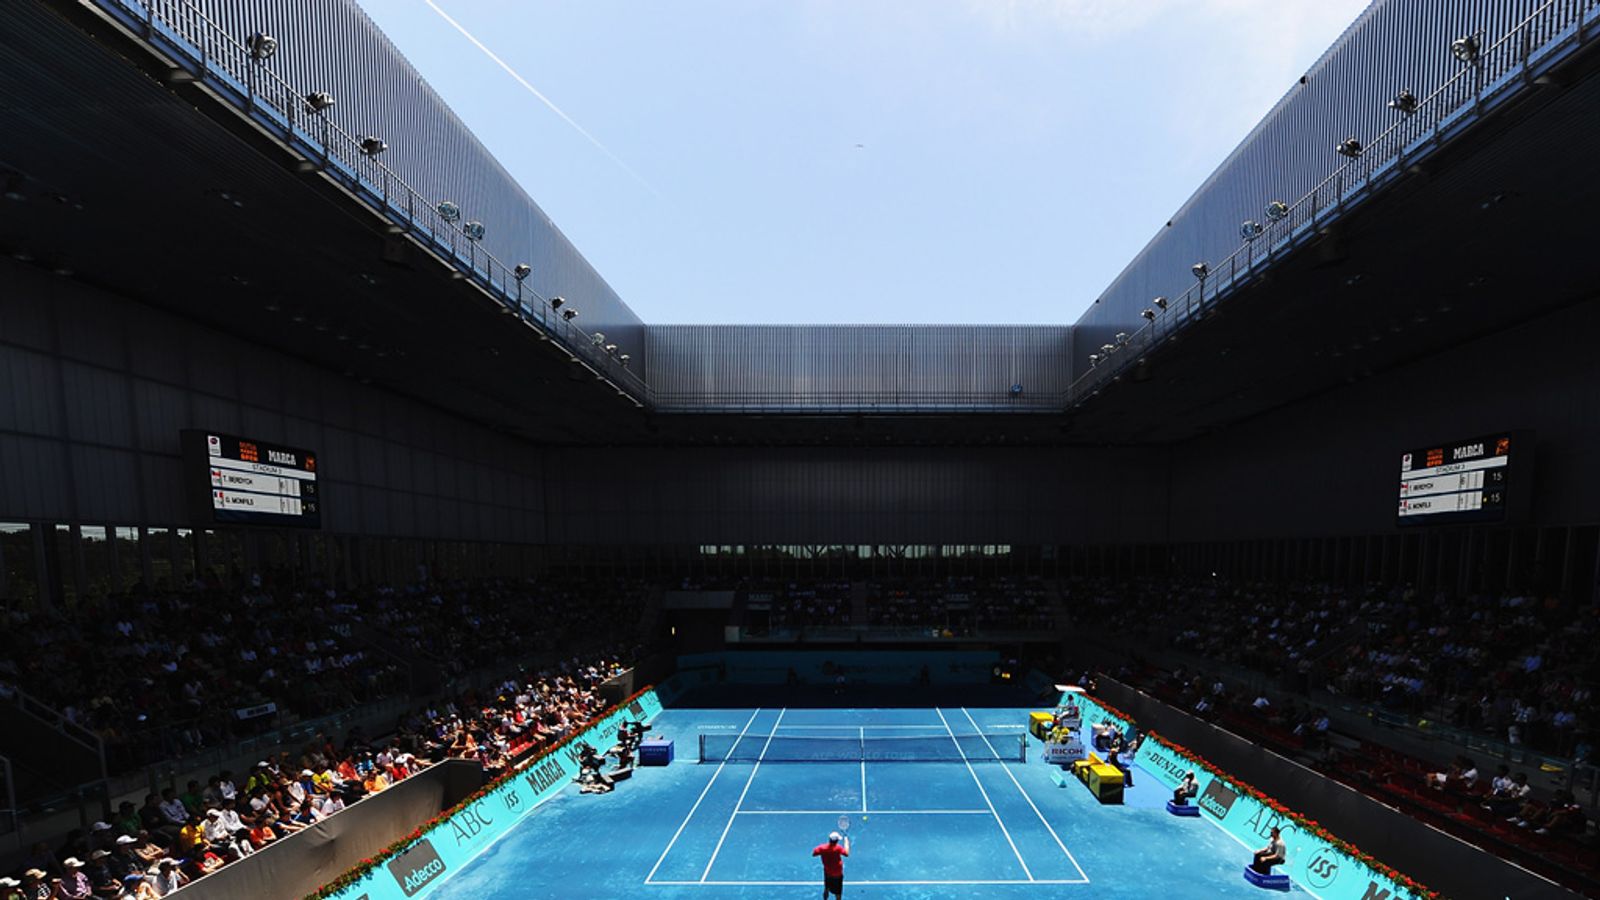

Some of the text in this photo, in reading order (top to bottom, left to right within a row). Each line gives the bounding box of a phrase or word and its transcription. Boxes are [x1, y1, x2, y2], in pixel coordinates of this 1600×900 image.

[268, 450, 296, 465] MARCA
[1453, 443, 1484, 460] MARCA
[1493, 472, 1502, 481] 15
[1491, 493, 1500, 502] 15
[525, 758, 566, 796] MARCA
[506, 790, 520, 809] ISS
[450, 801, 494, 847] ABC
[403, 858, 442, 892] Adecco
[1308, 855, 1338, 879] ISS
